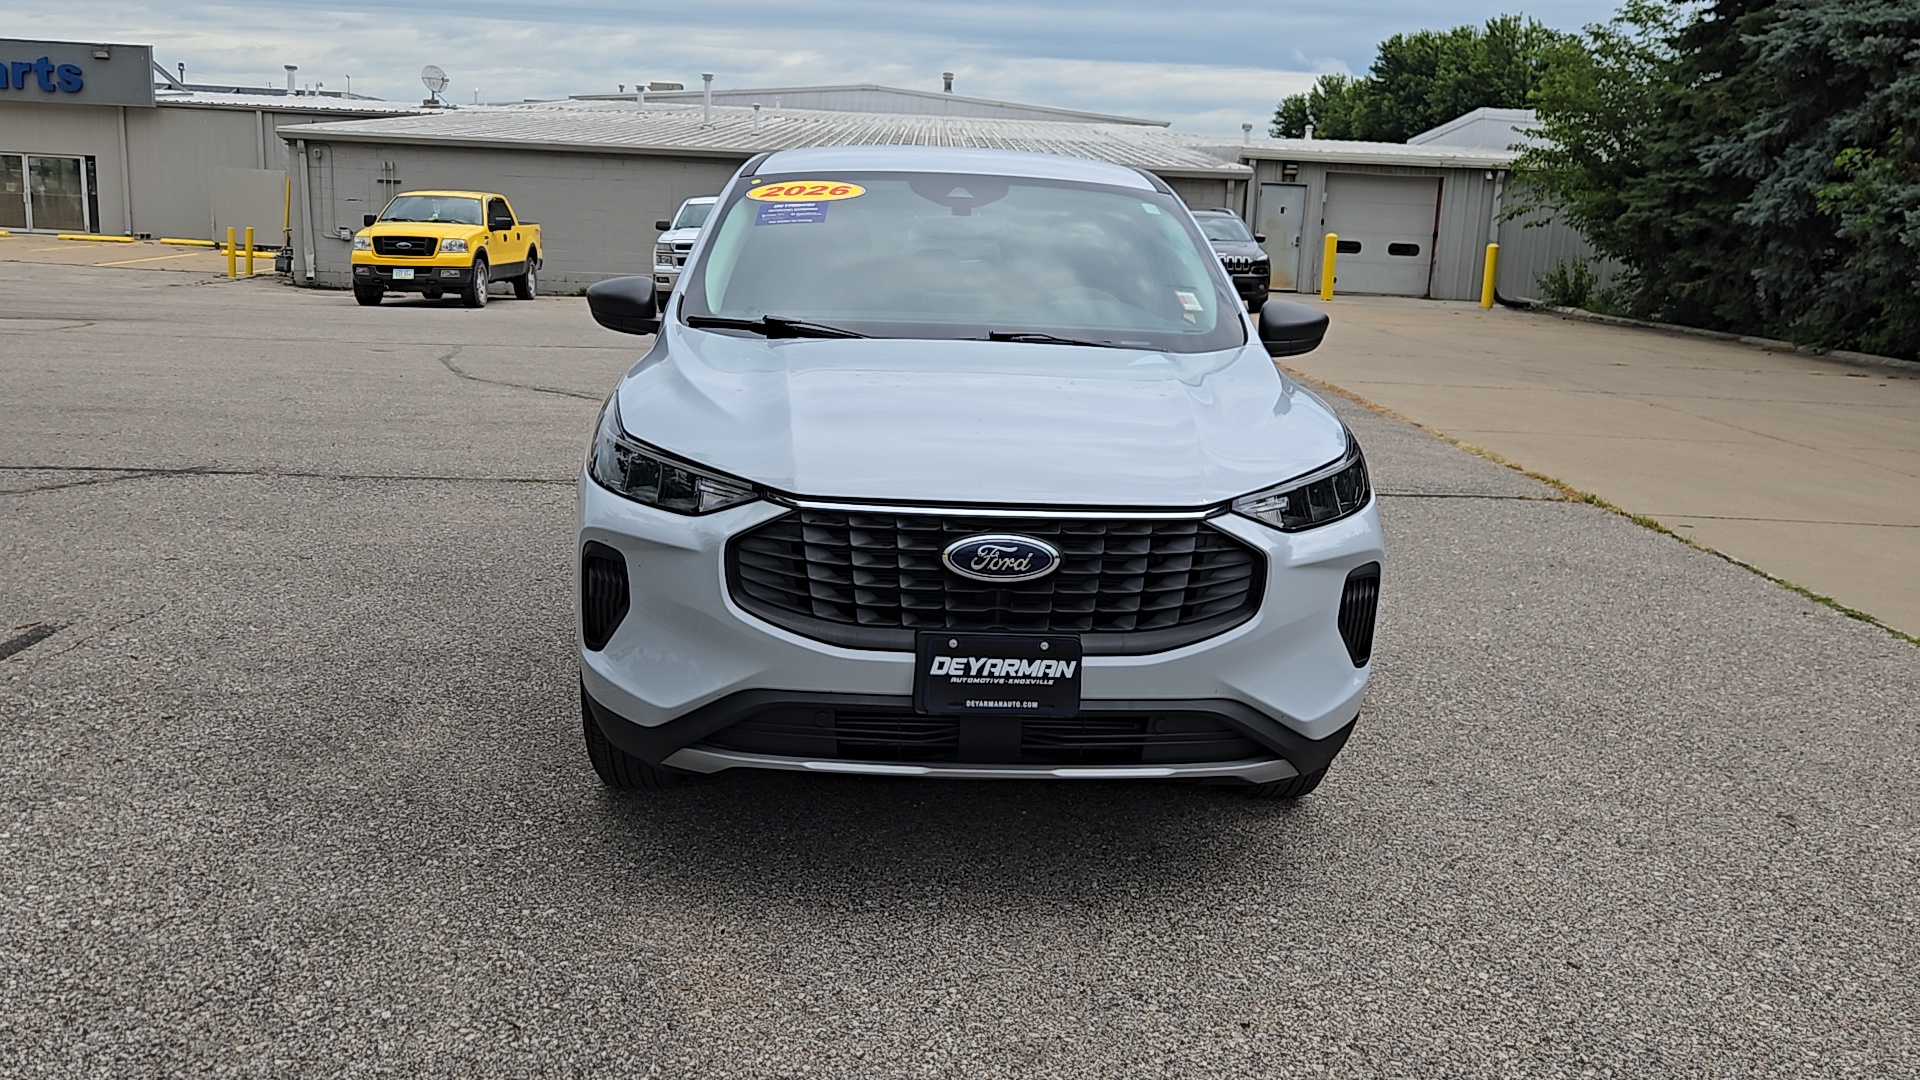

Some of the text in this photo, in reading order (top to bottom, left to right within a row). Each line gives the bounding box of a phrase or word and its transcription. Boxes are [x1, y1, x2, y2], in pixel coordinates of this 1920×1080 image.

[758, 186, 852, 197] 2026
[970, 545, 1033, 572] Ford
[930, 656, 1076, 678] DEYARMAN
[965, 699, 1039, 709] DEYARMANAUTO.COM
